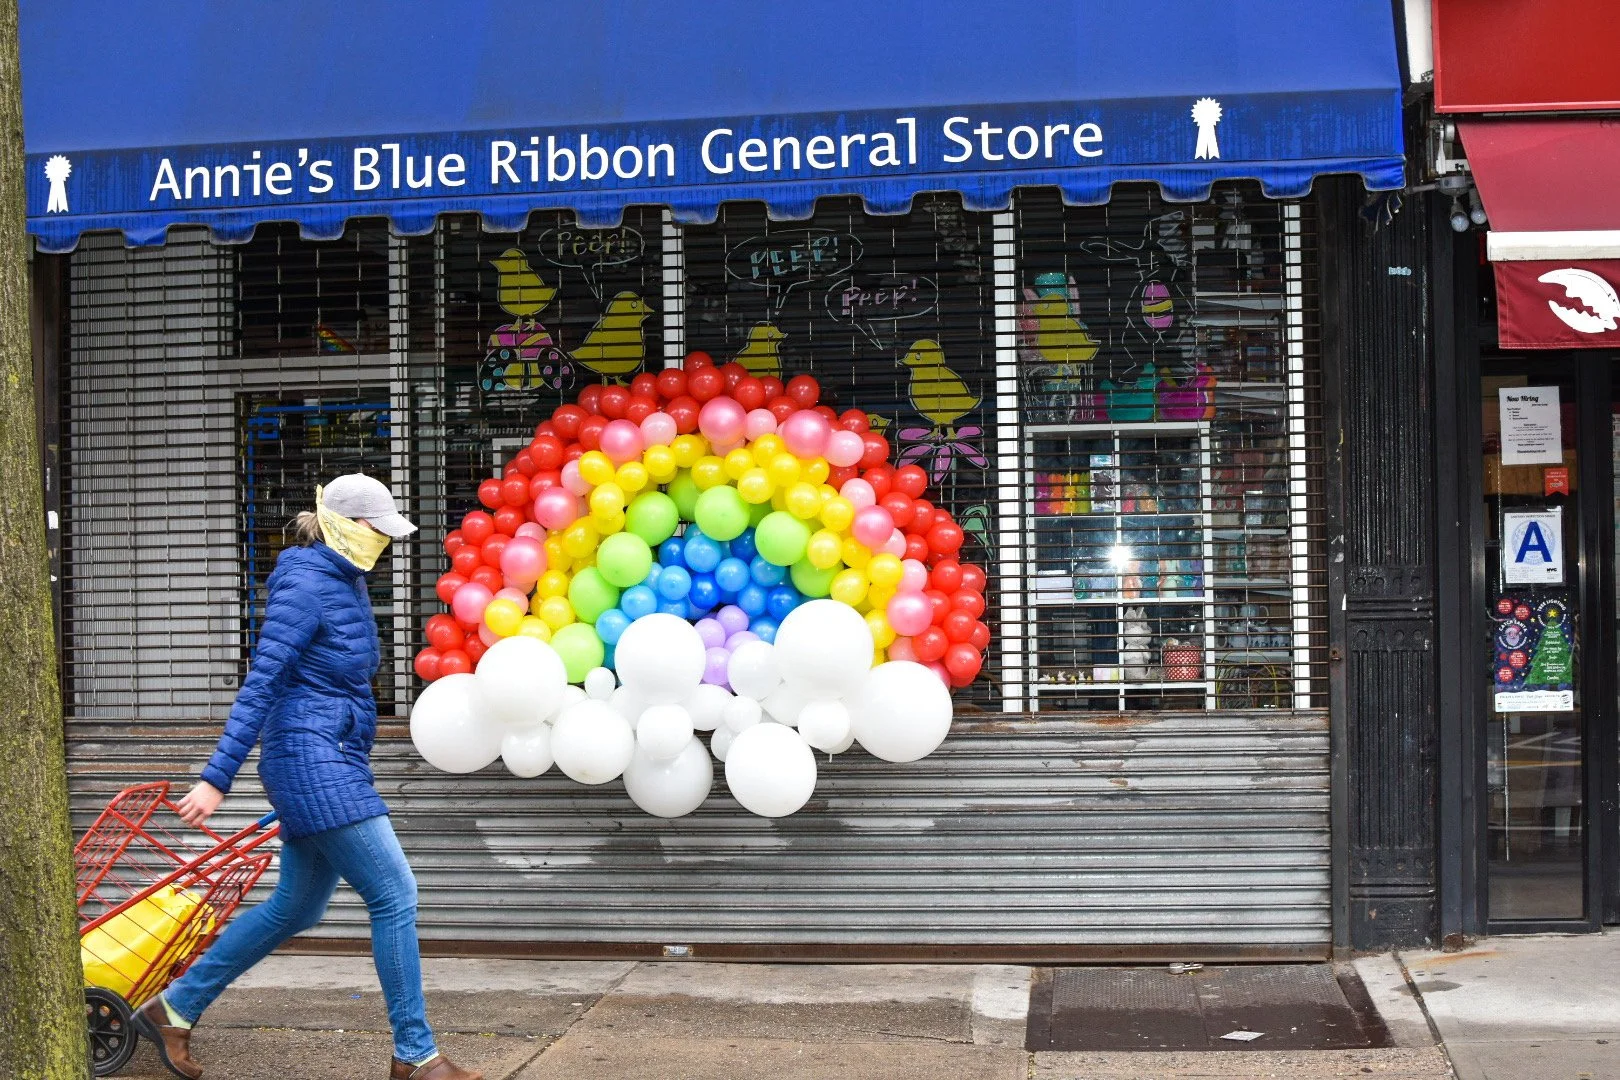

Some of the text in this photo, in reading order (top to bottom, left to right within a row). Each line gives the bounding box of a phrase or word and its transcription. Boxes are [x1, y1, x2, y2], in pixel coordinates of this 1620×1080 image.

[150, 117, 1103, 201] Annie's Blue Ribbon General Store
[1515, 521, 1552, 562] A
